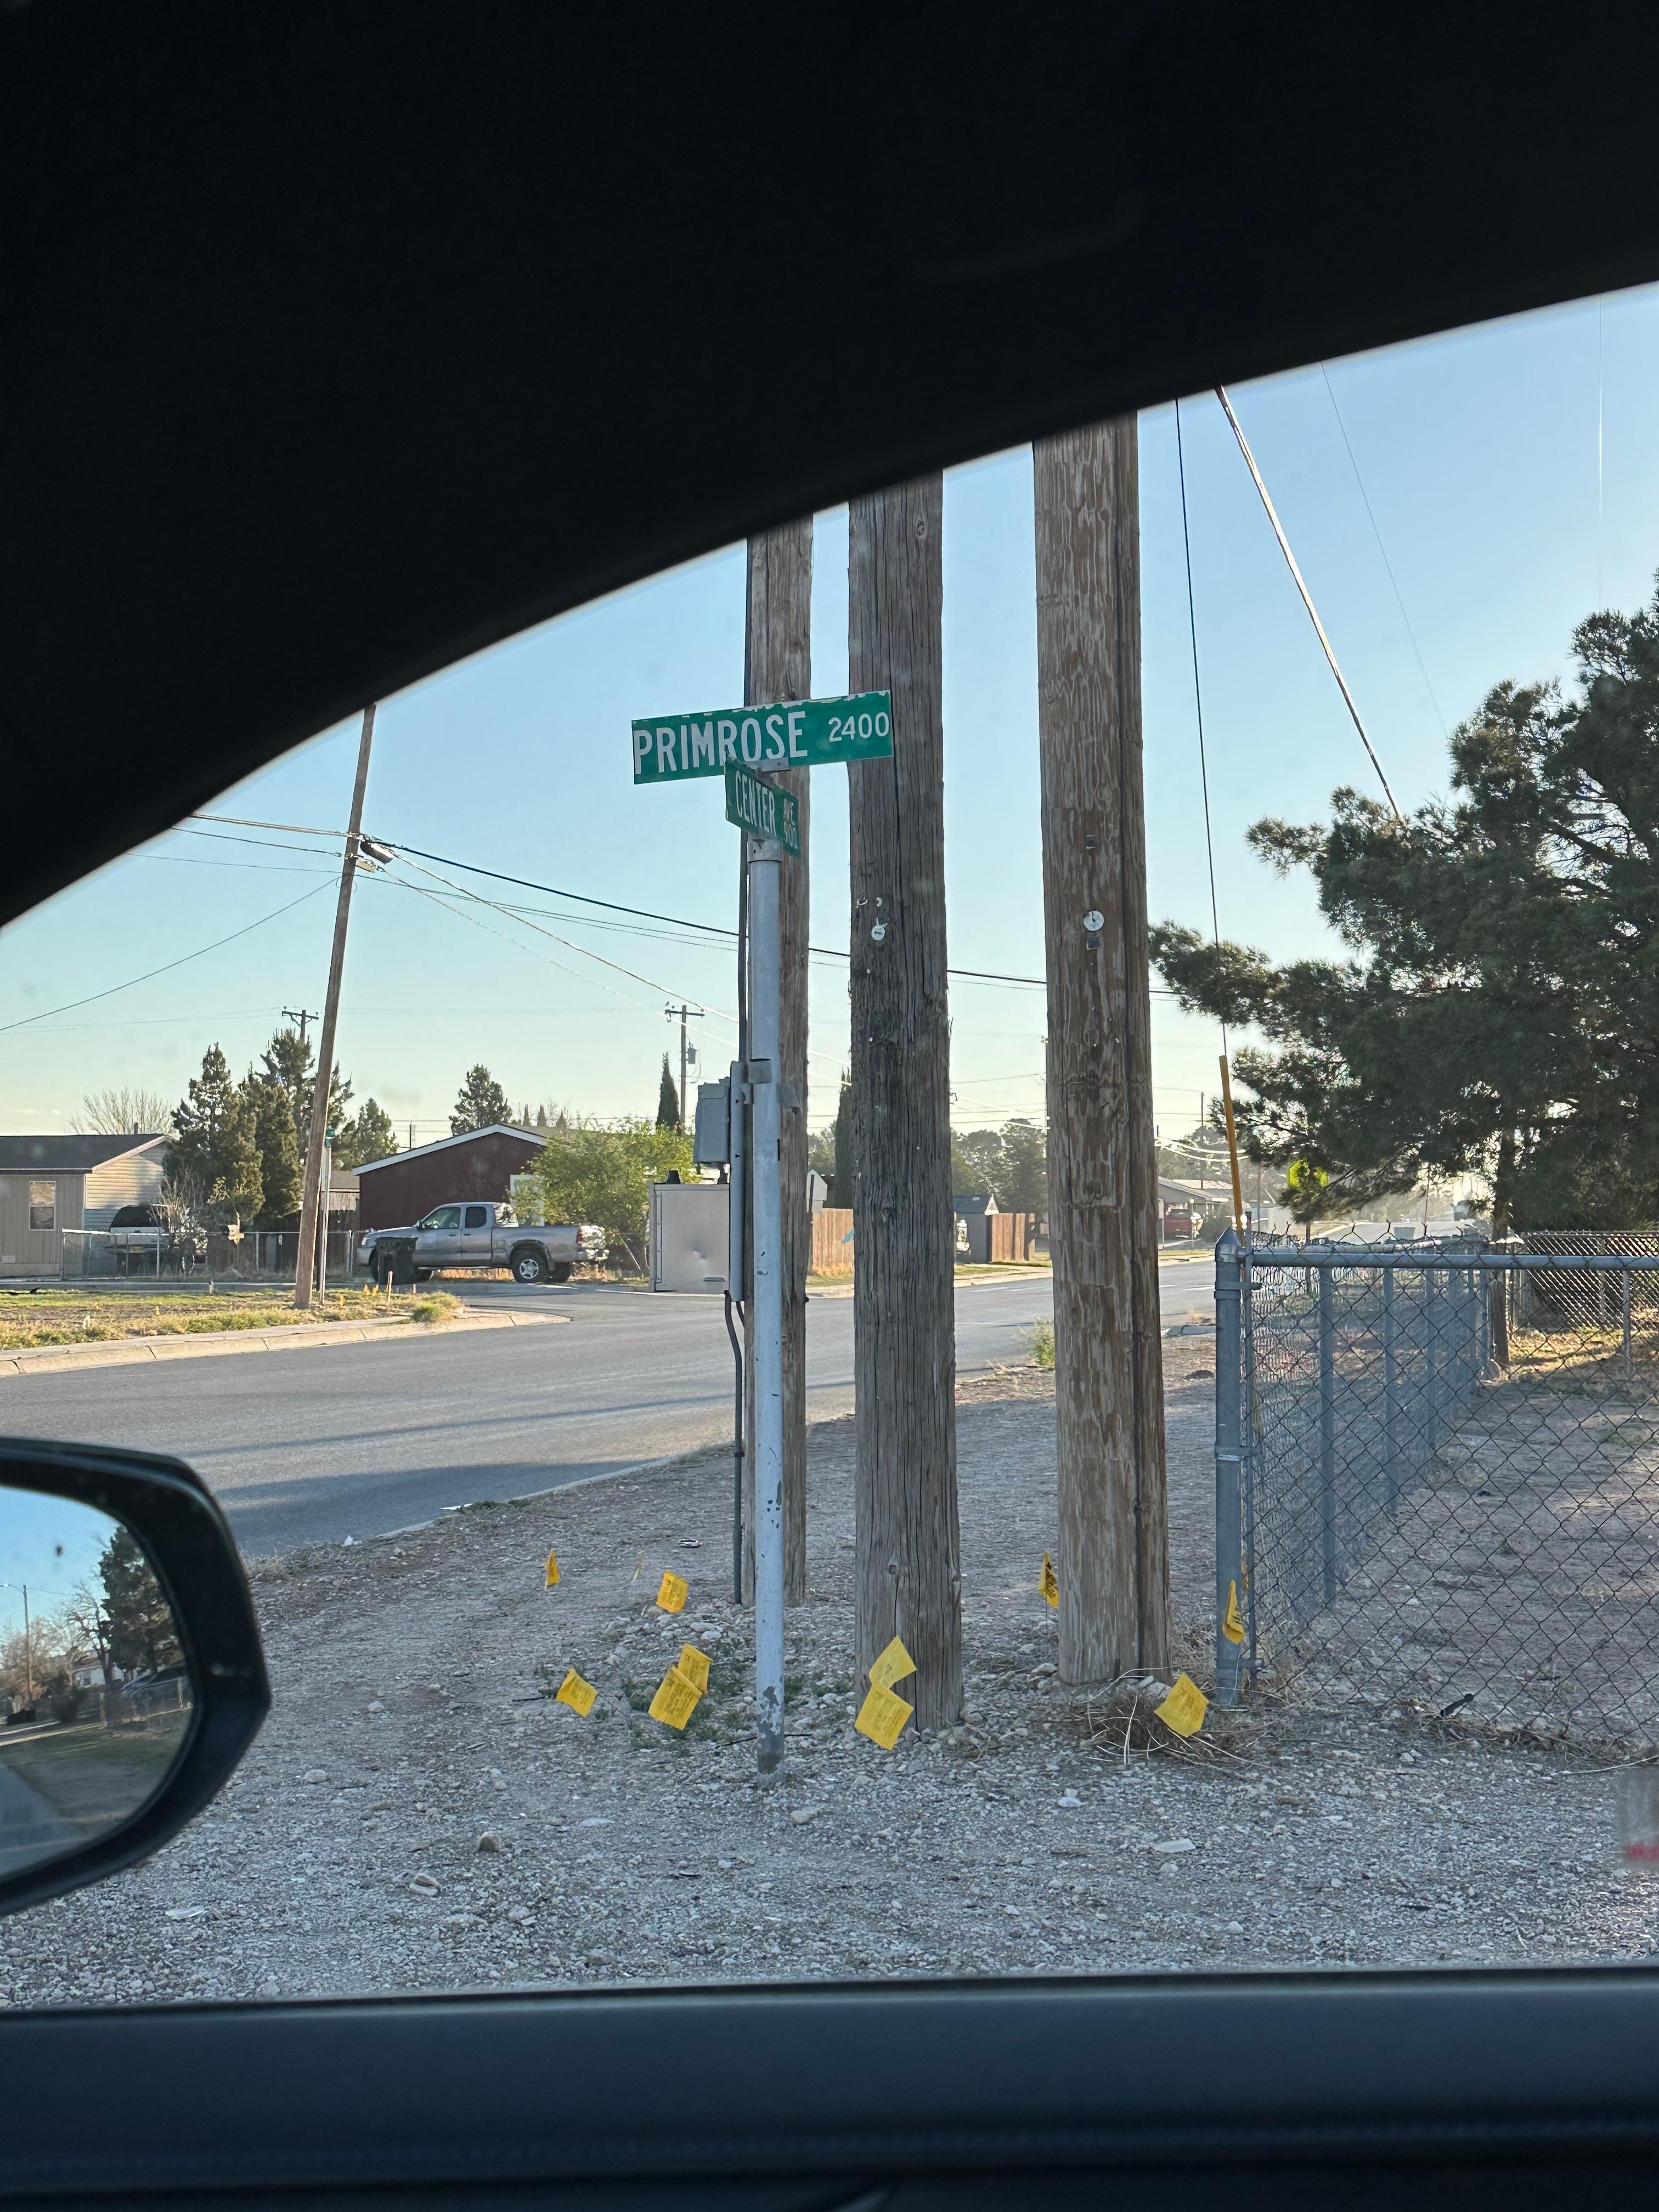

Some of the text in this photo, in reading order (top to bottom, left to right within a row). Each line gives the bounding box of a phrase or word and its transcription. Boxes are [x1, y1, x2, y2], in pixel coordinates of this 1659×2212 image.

[633, 711, 889, 775] PRIMROSE 2400
[735, 770, 777, 837] CENTER
